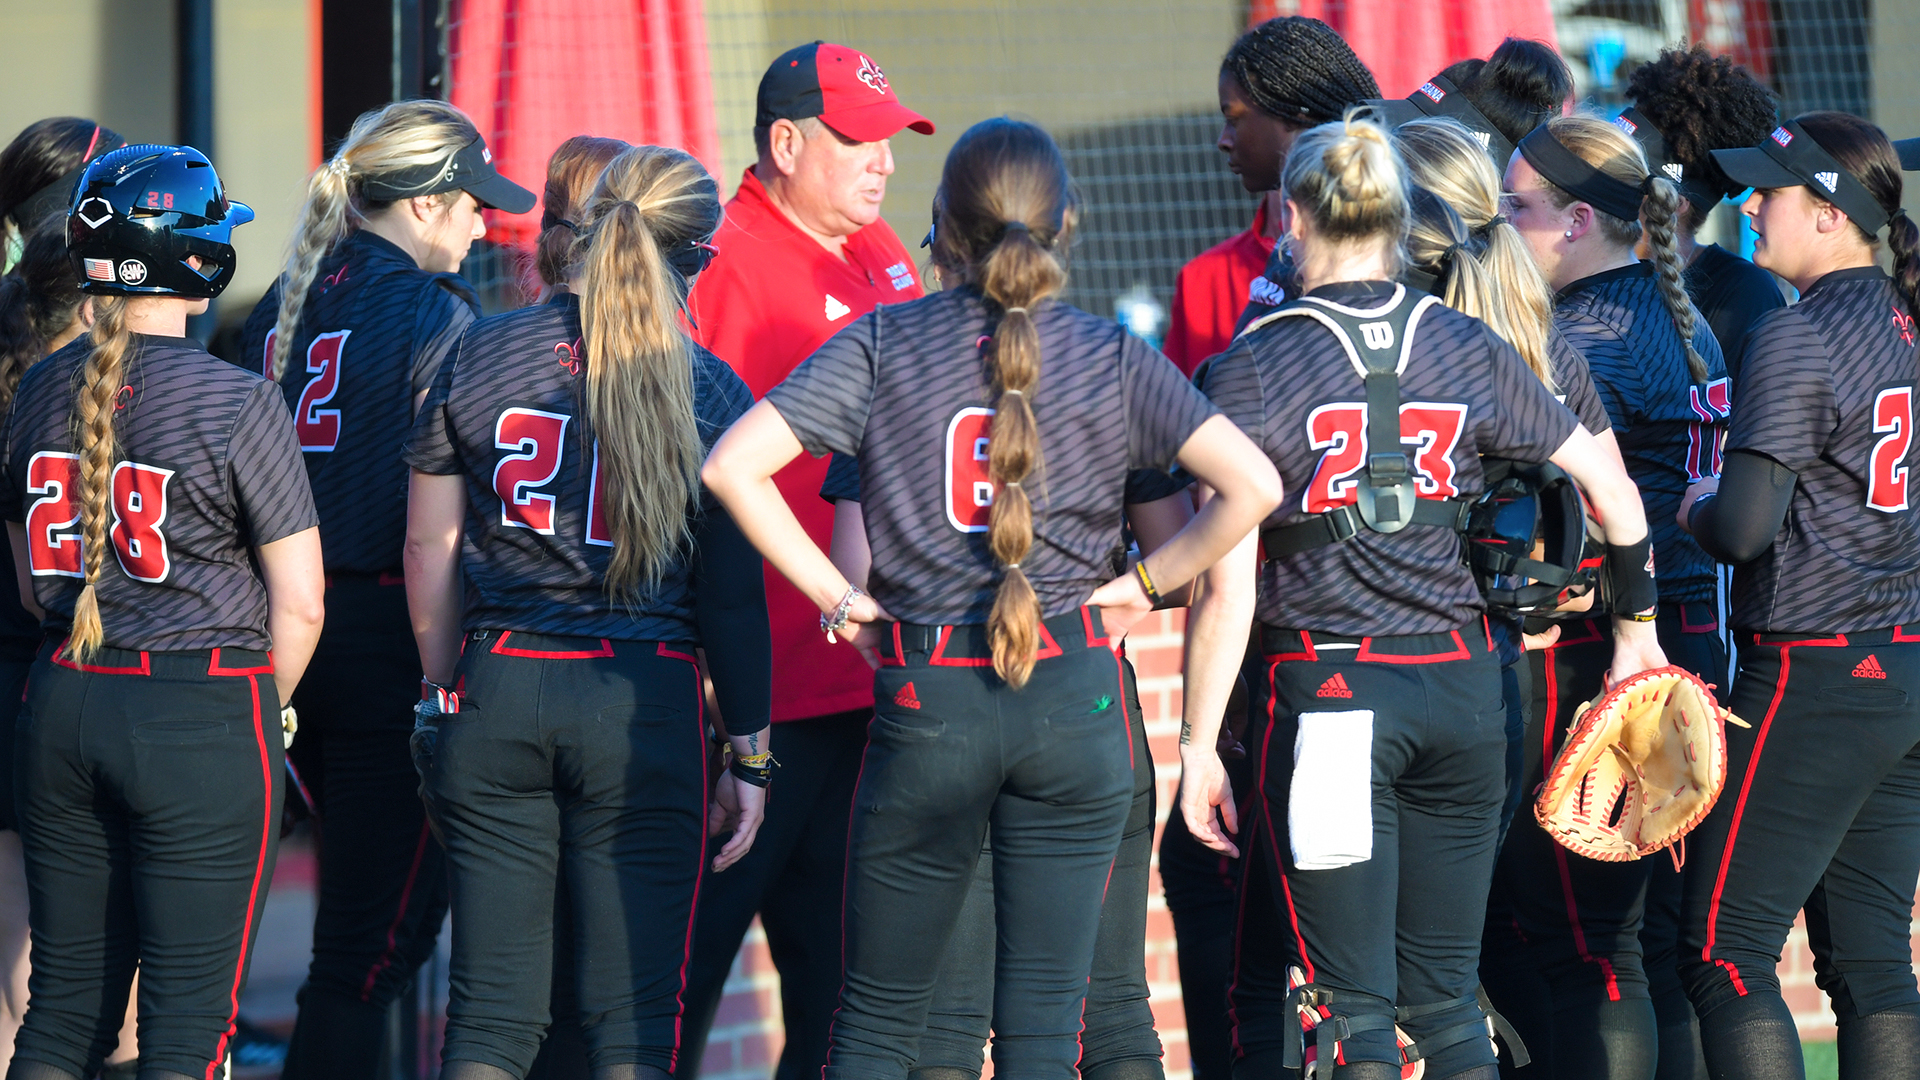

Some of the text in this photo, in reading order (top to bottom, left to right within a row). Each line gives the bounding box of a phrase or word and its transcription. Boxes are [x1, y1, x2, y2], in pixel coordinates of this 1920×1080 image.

[147, 191, 175, 209] 28
[1302, 402, 1468, 513] 23
[26, 451, 175, 583] 28
[1851, 667, 1887, 680] adidas
[1316, 687, 1353, 699] adidas
